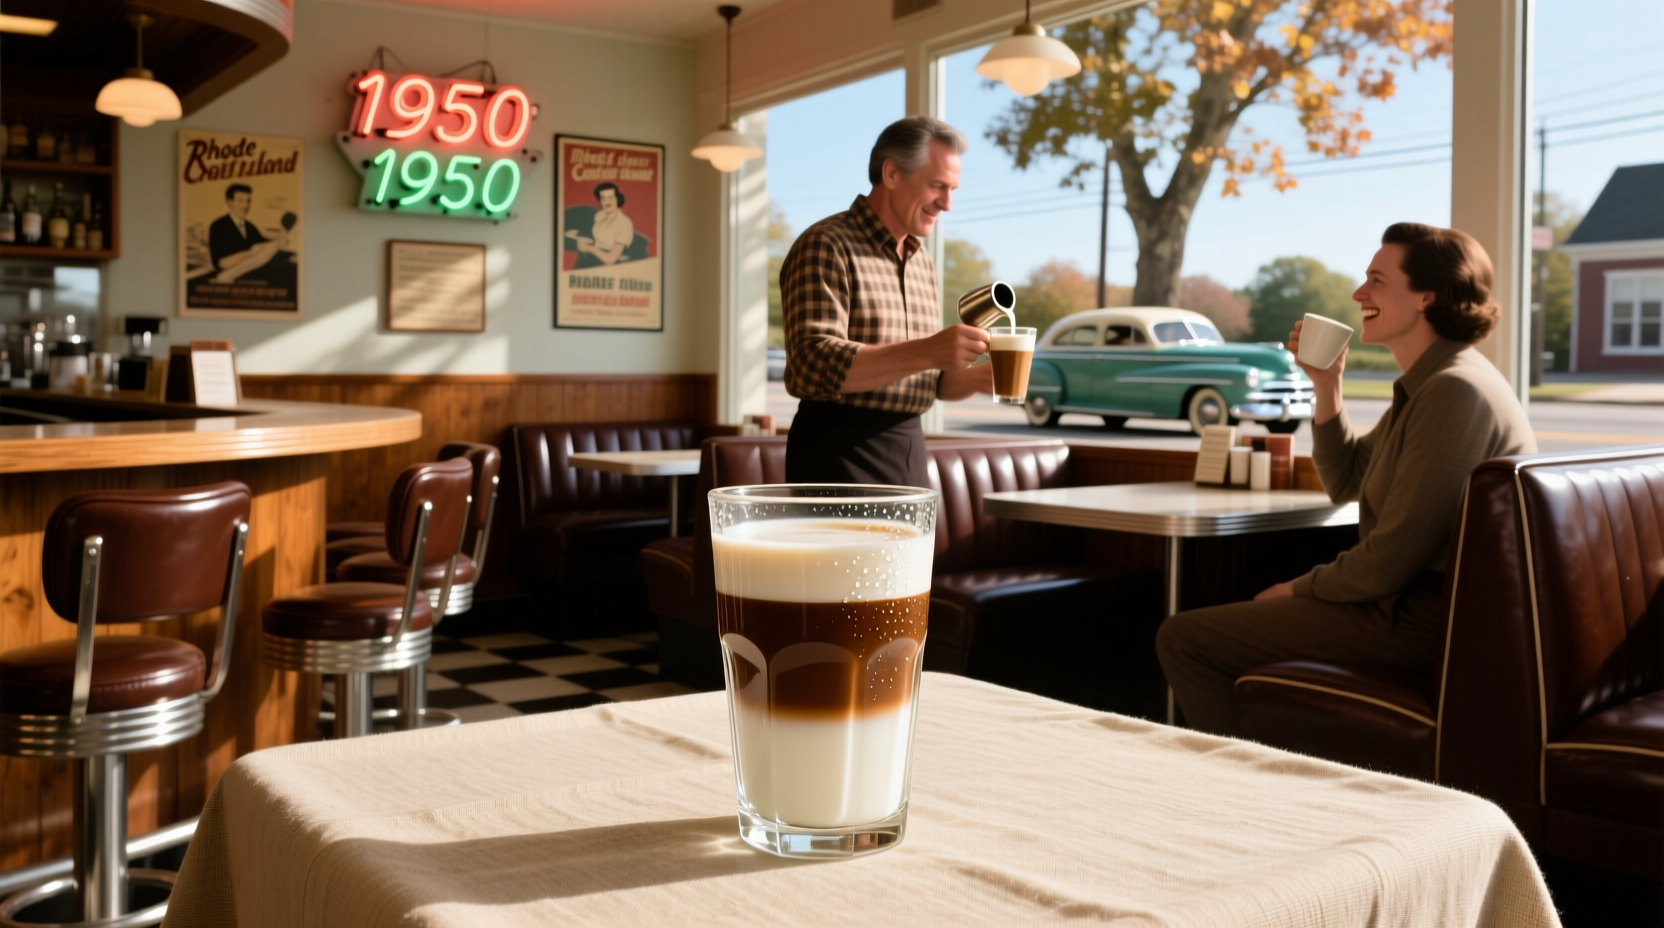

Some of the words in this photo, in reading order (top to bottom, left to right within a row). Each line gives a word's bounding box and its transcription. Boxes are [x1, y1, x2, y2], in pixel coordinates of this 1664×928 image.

[358, 73, 530, 148] 1950
[185, 137, 257, 172] Rhode
[373, 148, 521, 213] 1950
